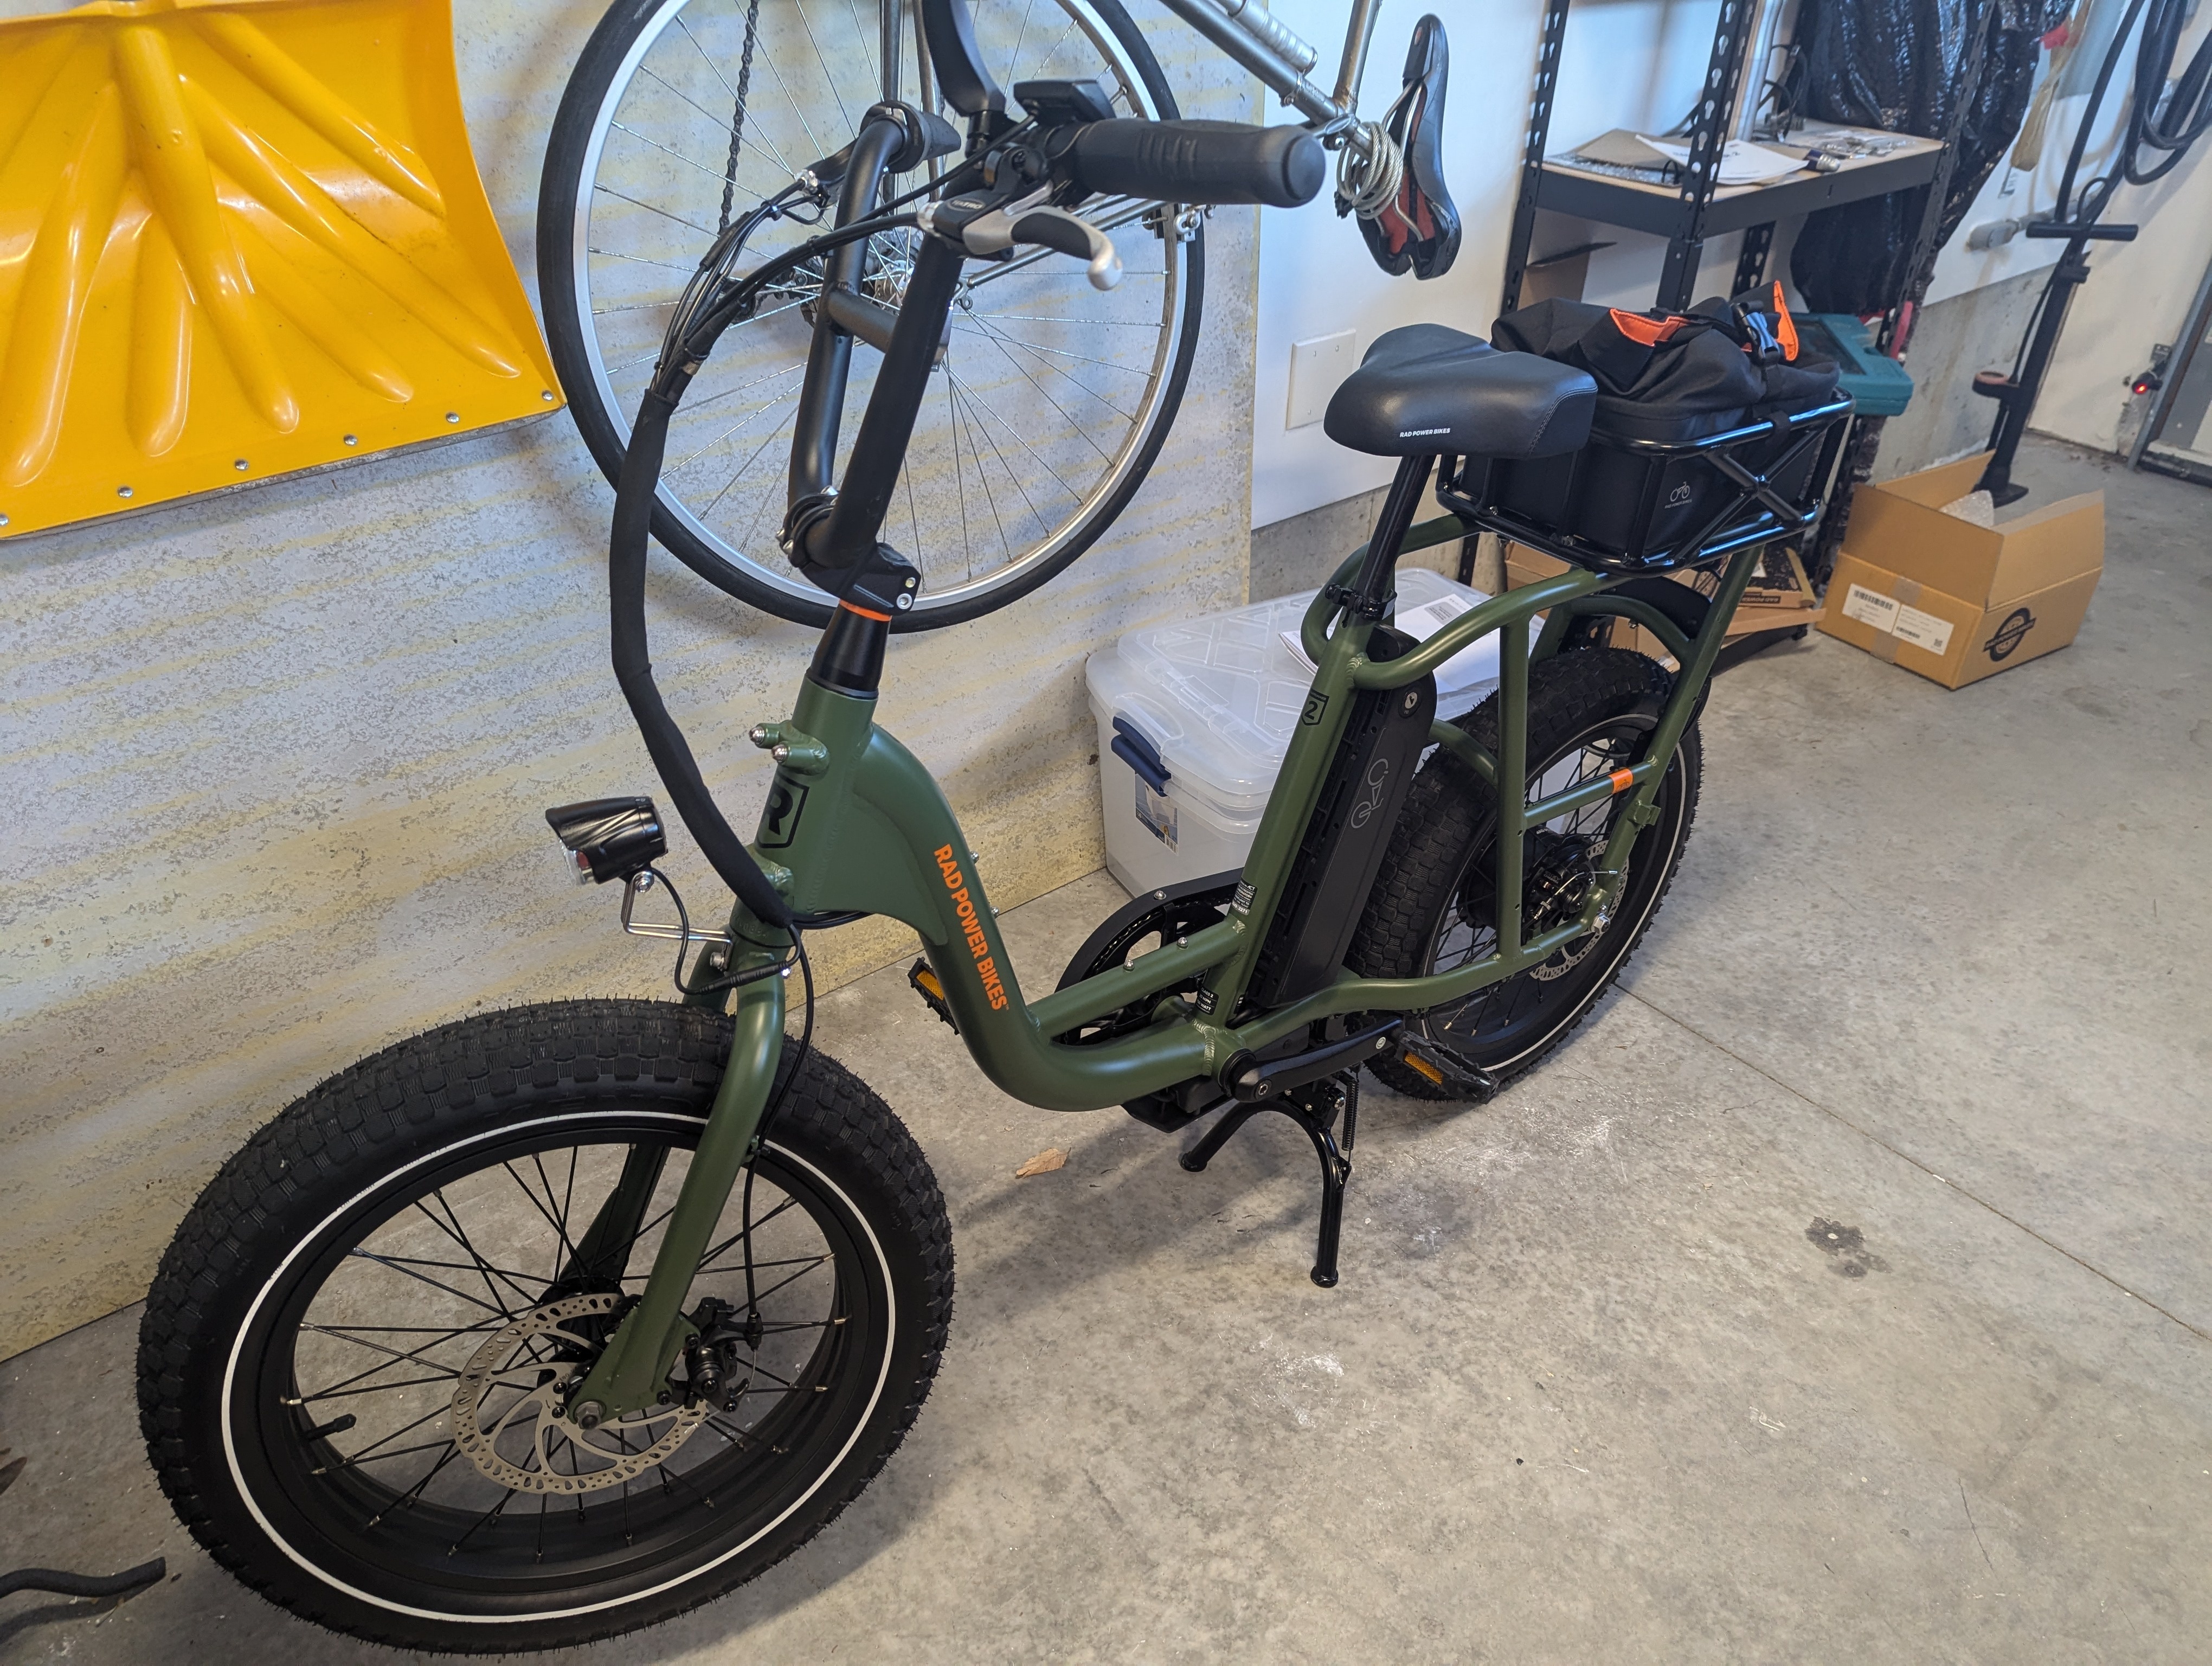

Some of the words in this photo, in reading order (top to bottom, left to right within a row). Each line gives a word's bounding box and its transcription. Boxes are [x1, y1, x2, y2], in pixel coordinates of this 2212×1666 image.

[1304, 701, 1318, 720] 2
[934, 843, 963, 889] RAD
[951, 887, 988, 959] POWER
[977, 956, 1007, 1010] BIKES
[1201, 988, 1210, 996] CLASS
[1200, 1002, 1212, 1011] WATT
